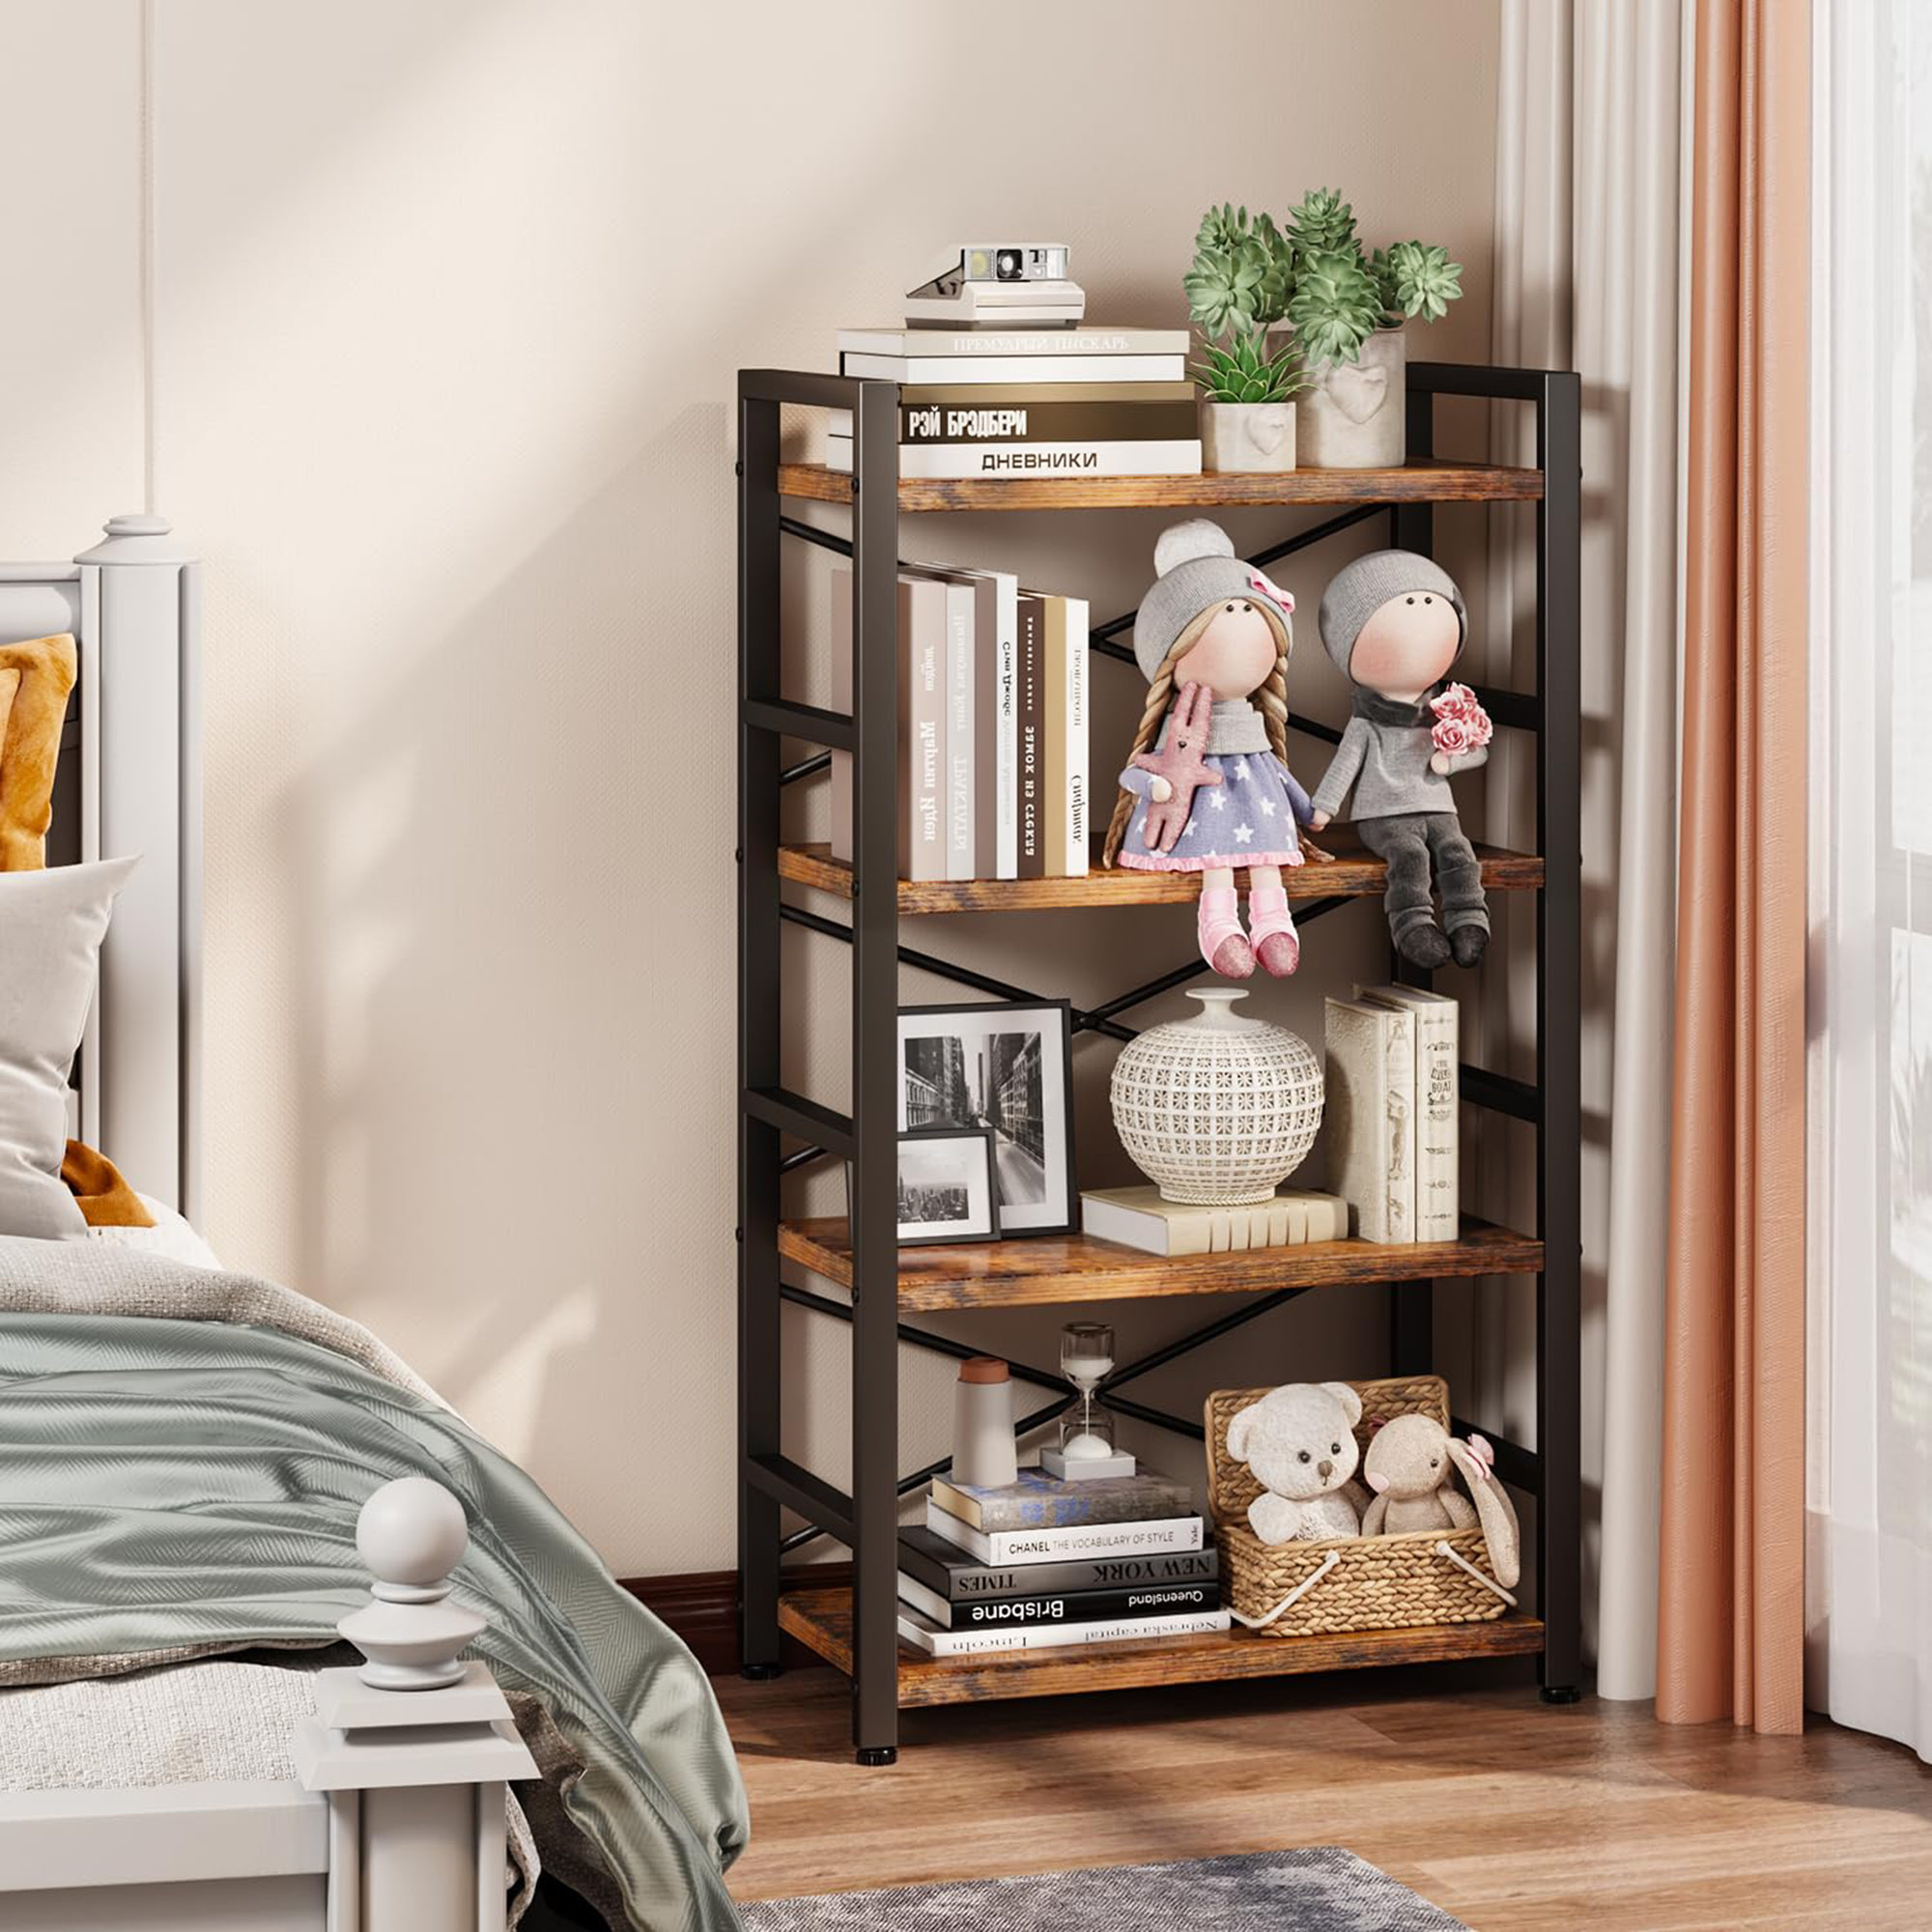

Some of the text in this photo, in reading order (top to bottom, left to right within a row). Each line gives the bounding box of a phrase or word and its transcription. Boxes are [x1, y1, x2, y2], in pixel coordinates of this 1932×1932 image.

[909, 406, 1028, 438] РЭЙ БРЭДБЕРИ
[981, 453, 1097, 470] ДНЕВНИКИ
[1009, 1541, 1050, 1555] CHANEL
[1053, 1540, 1069, 1549] THE
[1072, 1534, 1130, 1549] VOCABULARY
[1132, 1533, 1145, 1545] OF
[1147, 1531, 1174, 1544] STYLE
[1093, 1556, 1210, 1583] NEW YORK
[958, 1574, 1017, 1592] TIMES
[1128, 1590, 1204, 1607] Queensland
[972, 1600, 1064, 1621] Brisbane
[1085, 1620, 1217, 1641] Nebraska capital
[953, 1636, 1027, 1652] Lincoln
